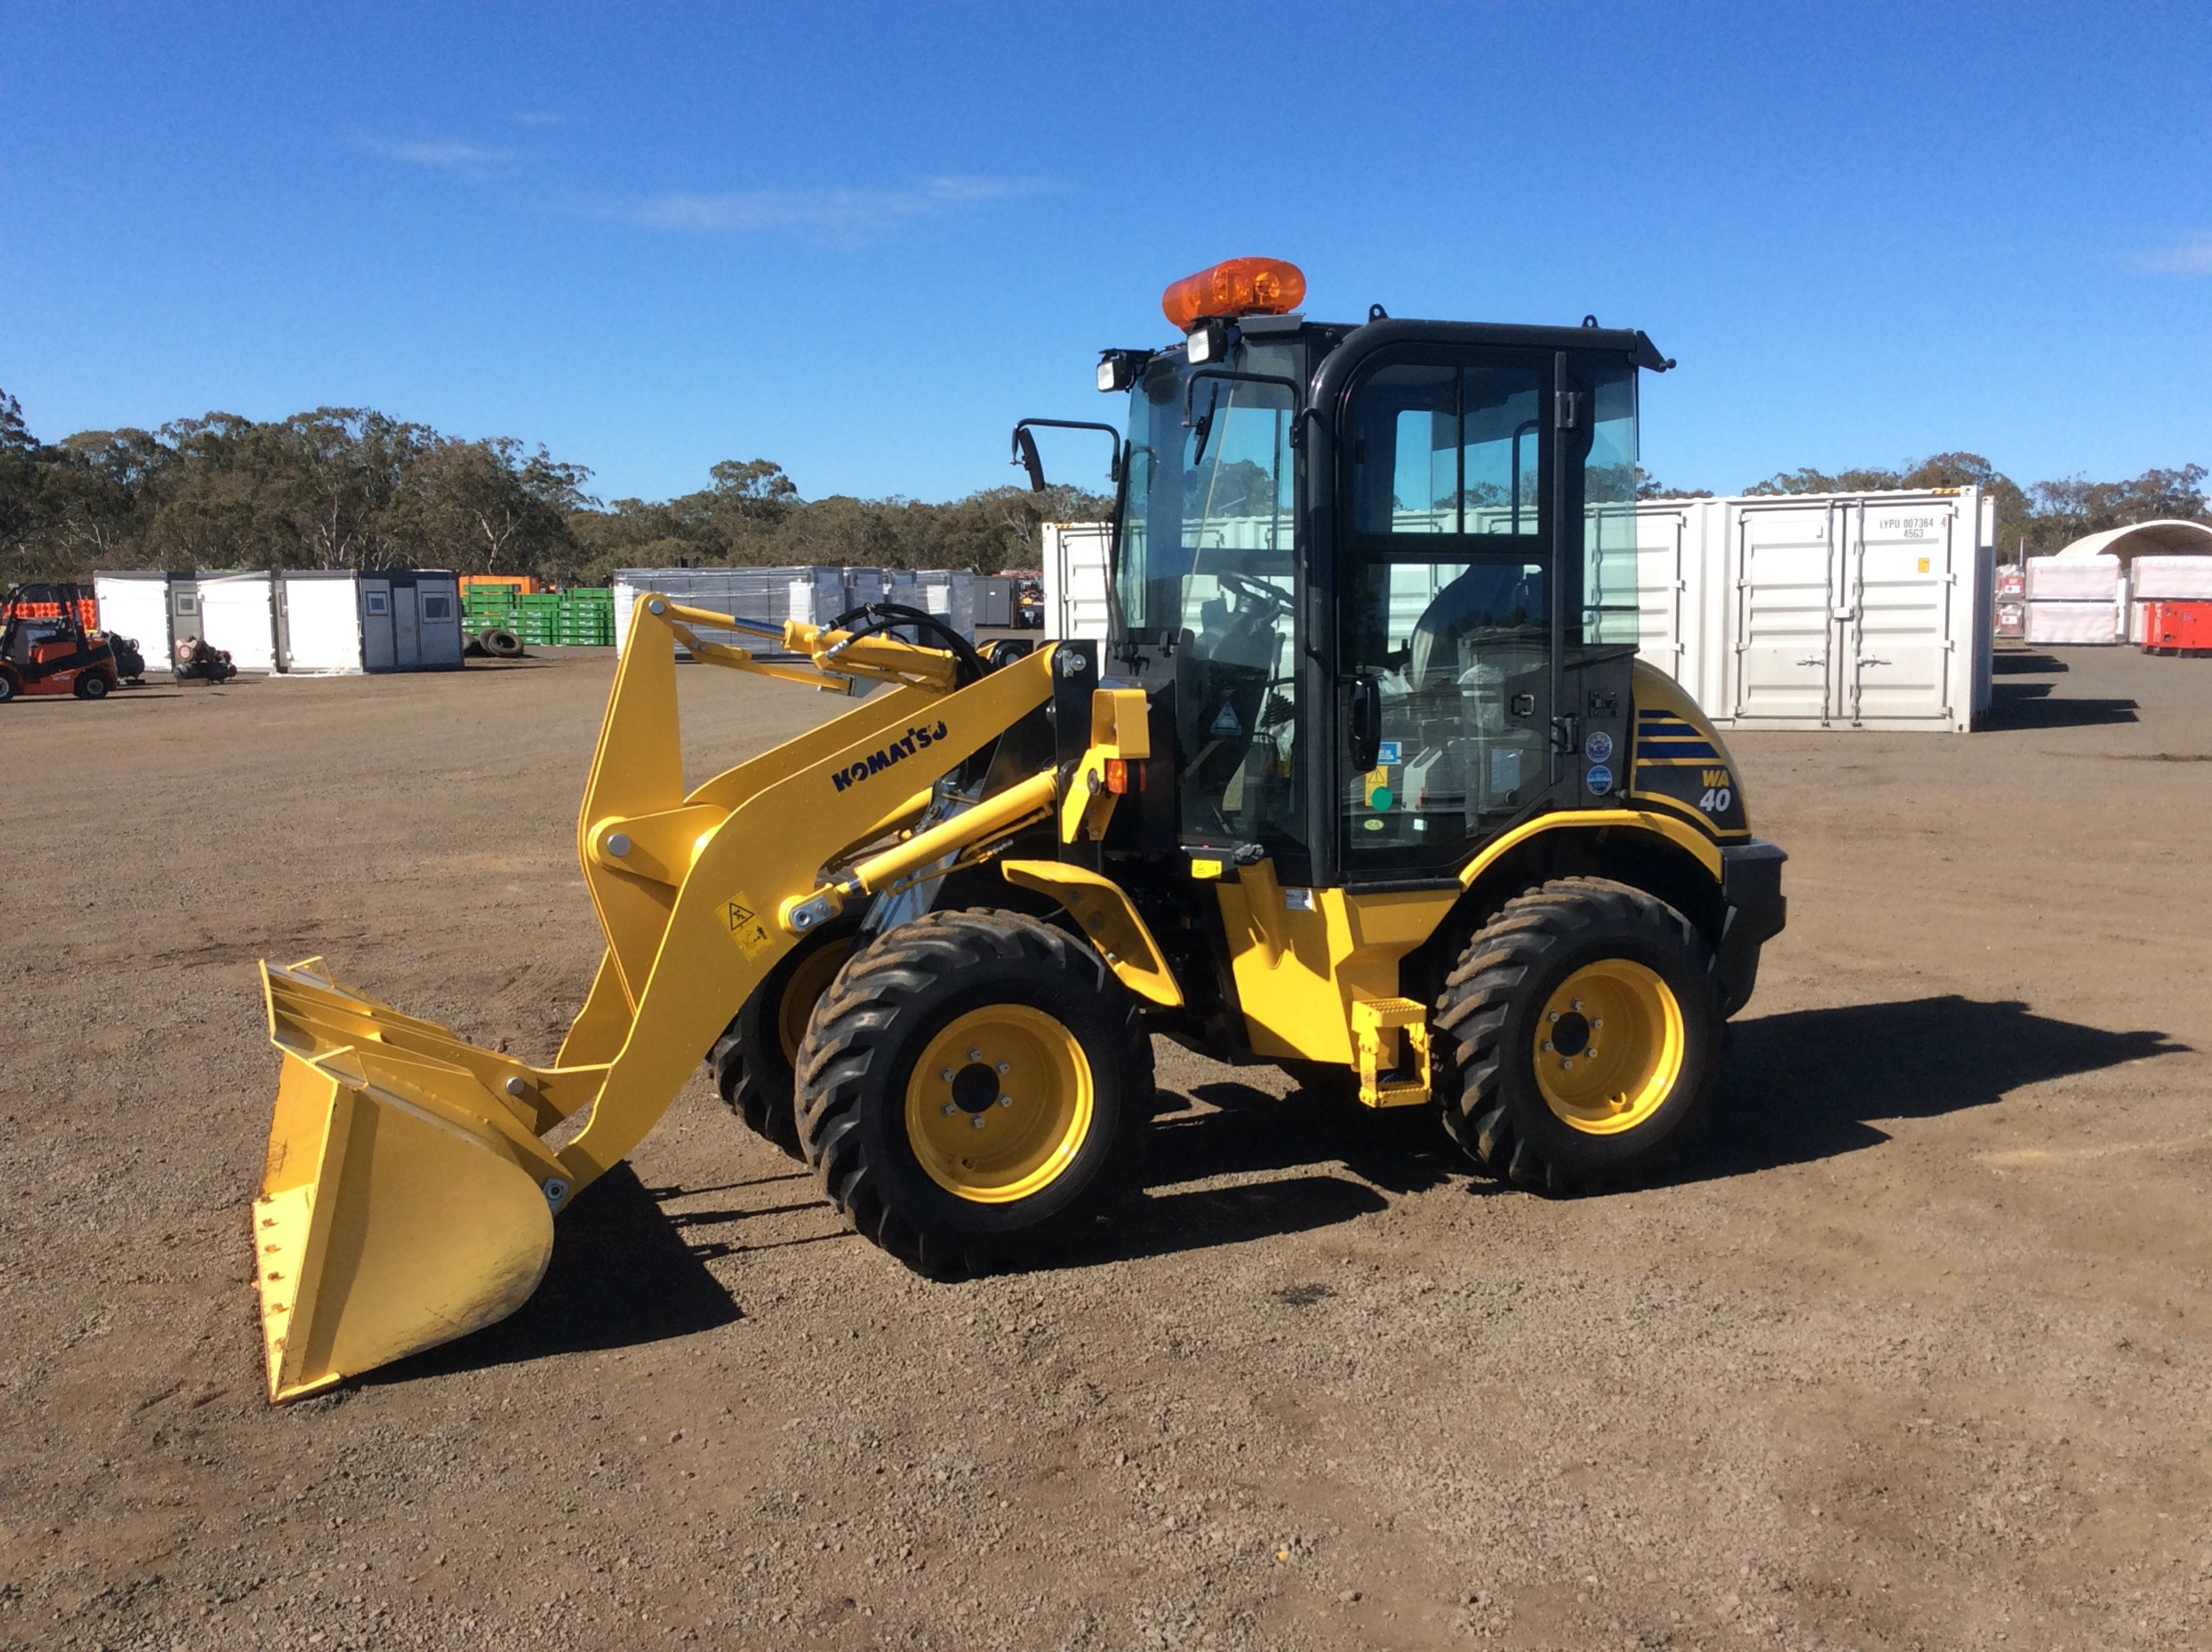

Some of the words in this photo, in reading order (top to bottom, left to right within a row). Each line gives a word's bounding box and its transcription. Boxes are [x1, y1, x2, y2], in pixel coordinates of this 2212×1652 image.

[1879, 519, 1900, 529] LYPU
[1903, 518, 1934, 528] 007364
[1903, 529, 1924, 538] 45G3
[831, 720, 948, 792] KOMATSU
[1702, 770, 1729, 787] WA
[1699, 789, 1731, 812] 40
